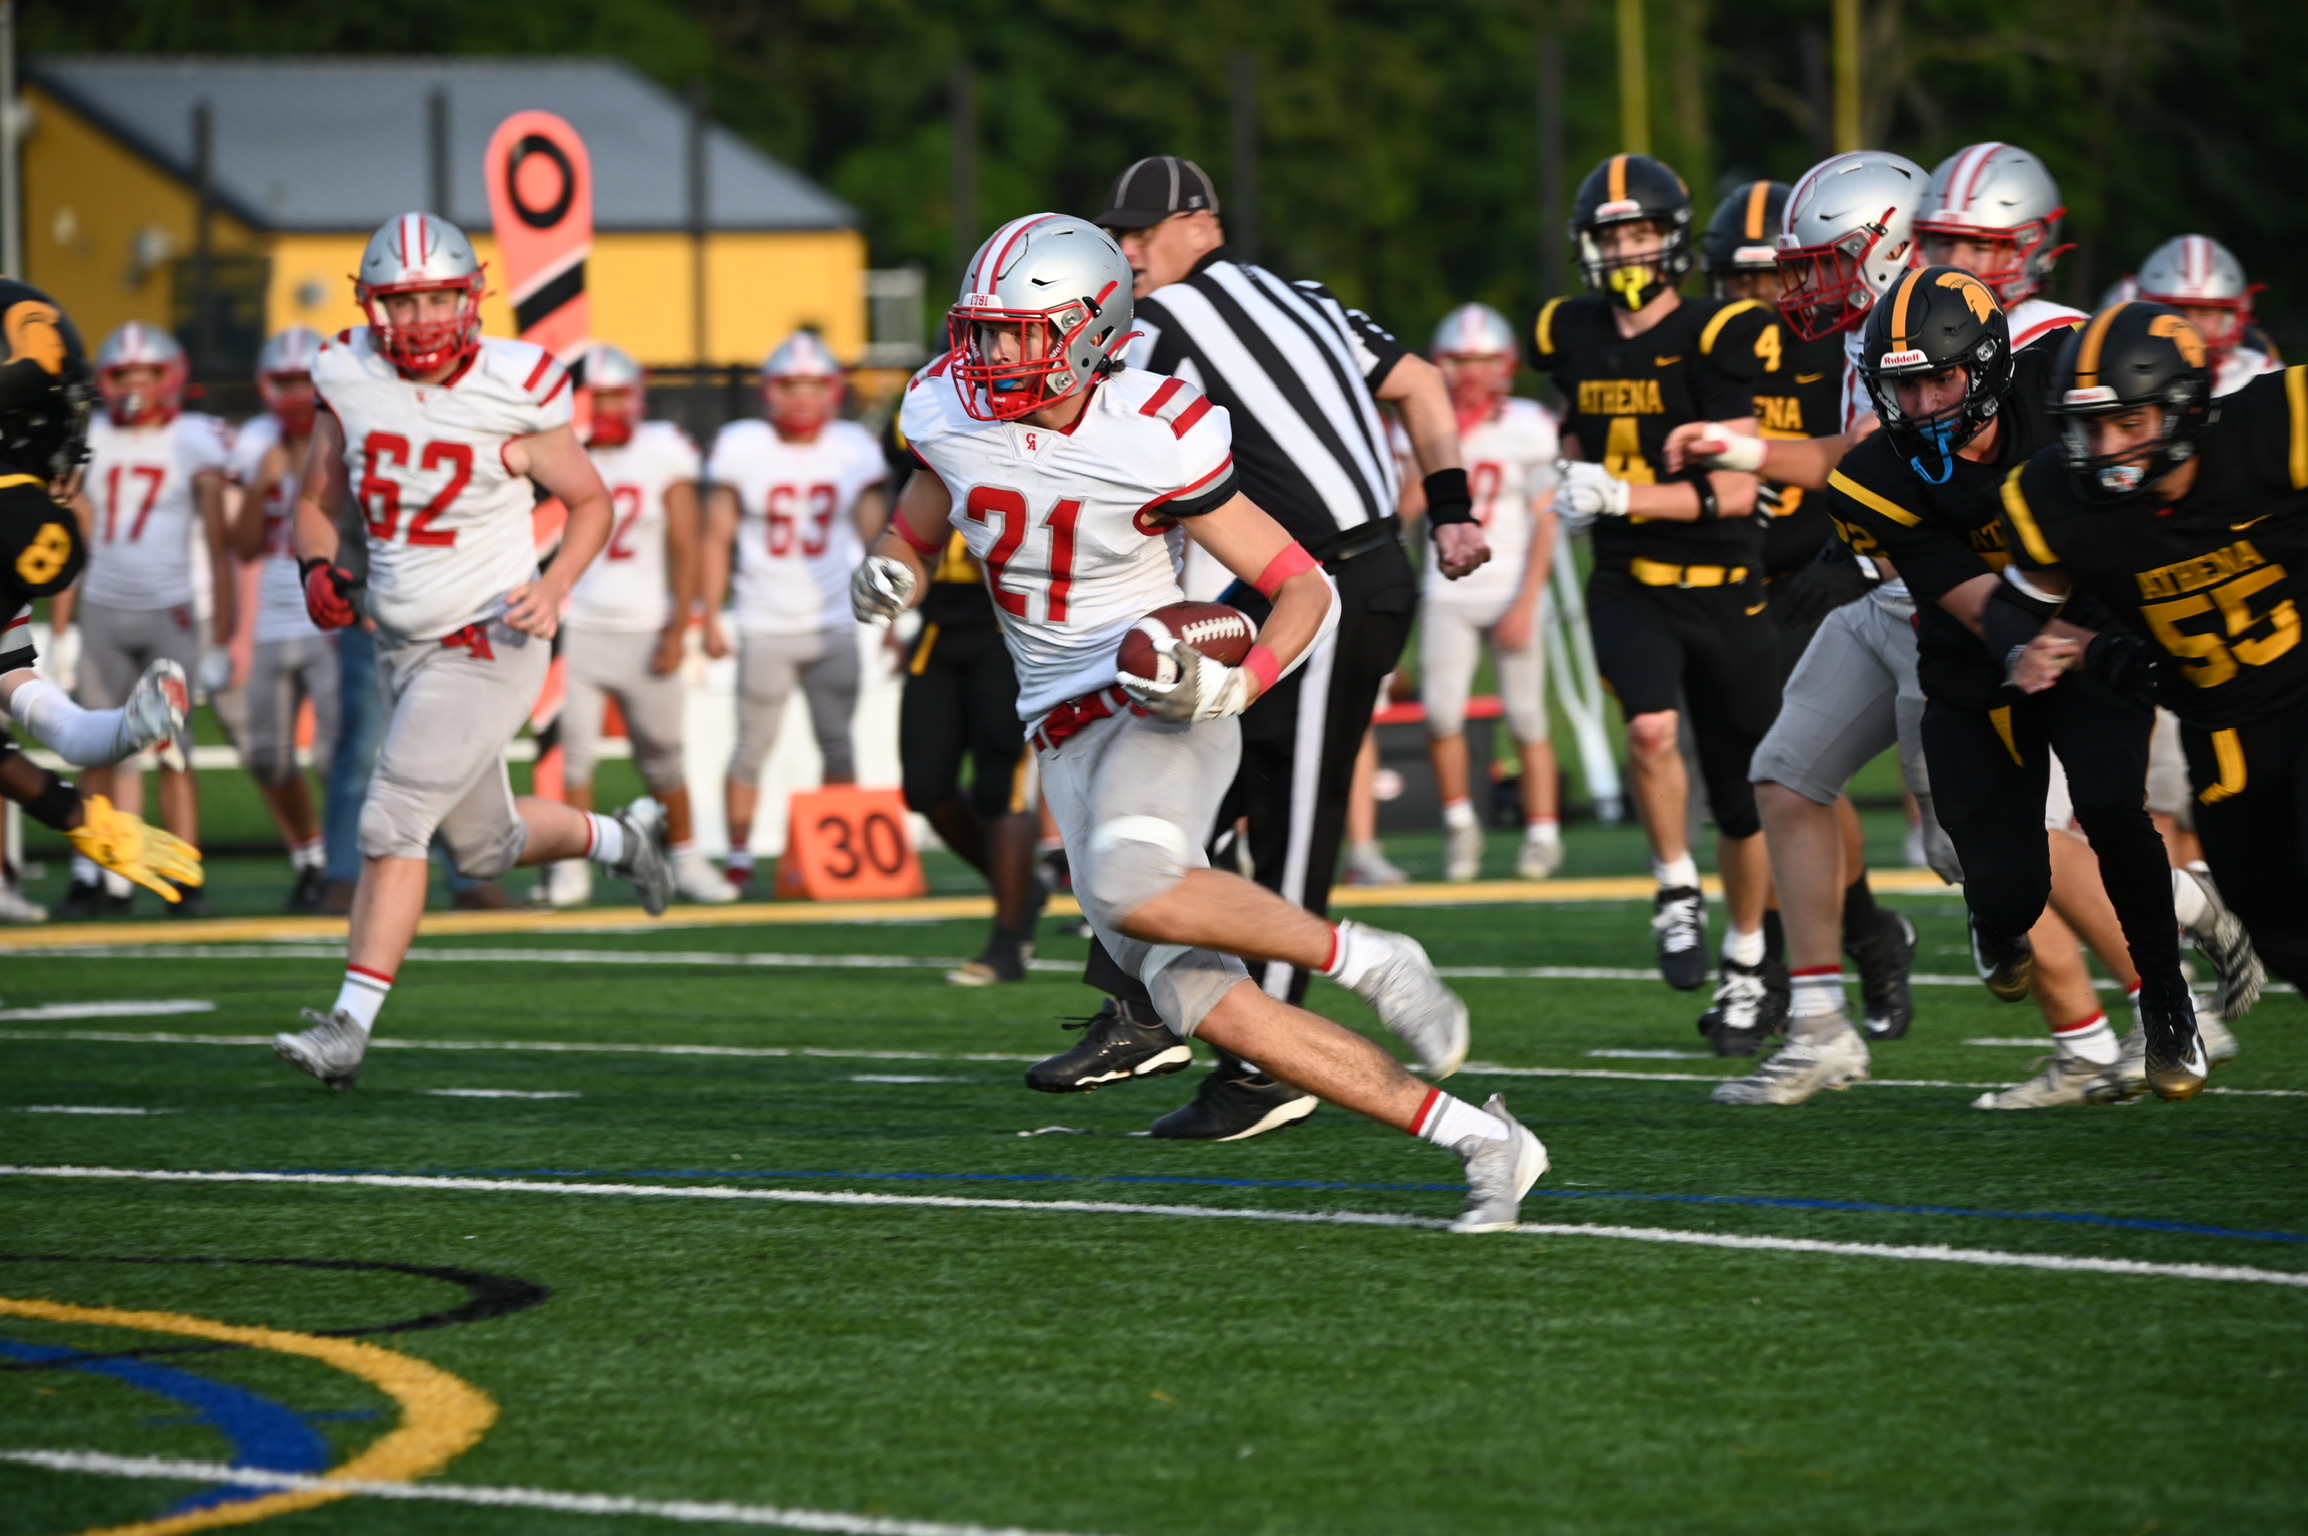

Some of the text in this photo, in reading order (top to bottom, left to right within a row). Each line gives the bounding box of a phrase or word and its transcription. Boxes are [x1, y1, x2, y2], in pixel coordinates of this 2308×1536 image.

[970, 294, 989, 307] 1791
[1754, 323, 1782, 372] 4
[1883, 353, 1920, 366] Riddell
[1577, 379, 1666, 415] ATHENA
[1752, 395, 1804, 430] ENA
[105, 465, 166, 544] 17
[358, 430, 474, 546] 62
[764, 483, 842, 558] 63
[15, 521, 72, 585] 8
[963, 483, 1086, 626] 21
[2134, 539, 2267, 600] ATHENA
[2138, 563, 2303, 689] 55
[816, 812, 906, 880] 30
